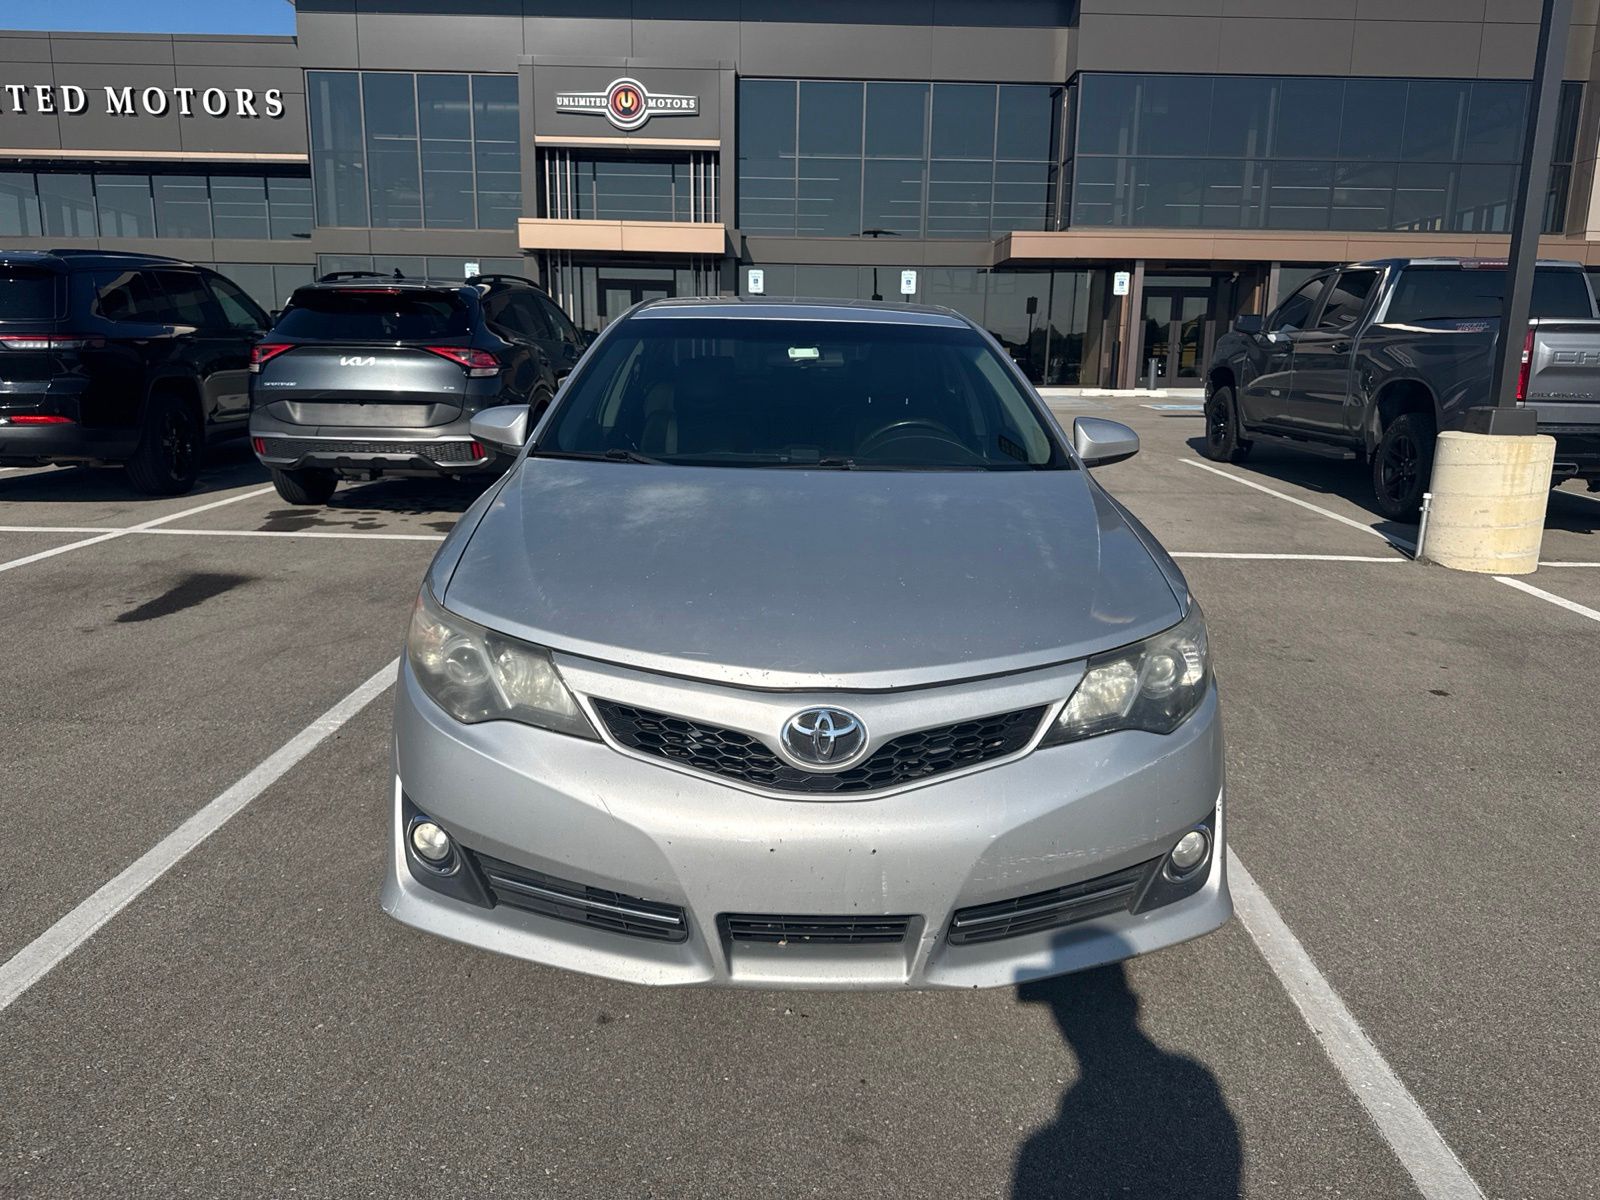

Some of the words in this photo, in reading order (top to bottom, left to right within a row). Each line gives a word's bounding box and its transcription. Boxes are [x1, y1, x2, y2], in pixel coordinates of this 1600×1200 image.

[104, 86, 284, 116] MOTORS
[556, 97, 608, 106] UNLIMITED
[647, 98, 696, 108] MOTORS
[340, 356, 376, 366] KIA
